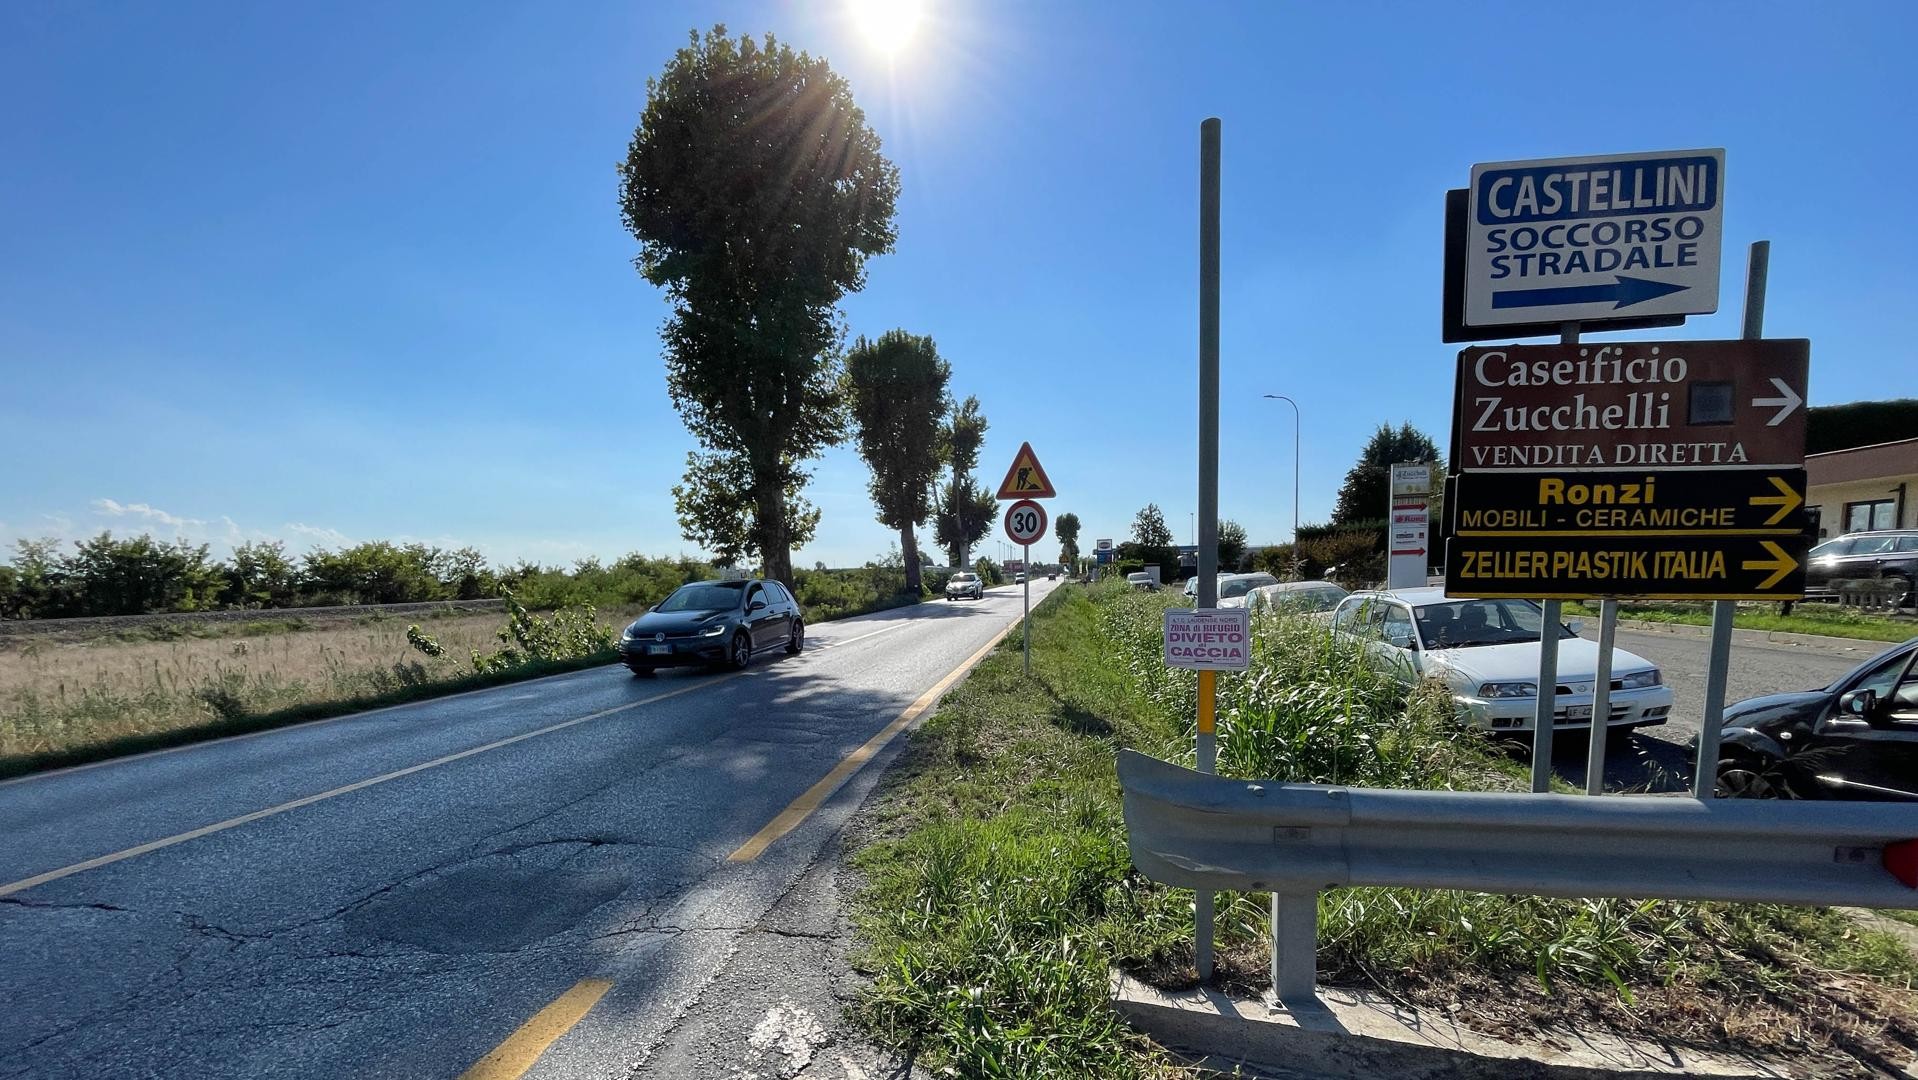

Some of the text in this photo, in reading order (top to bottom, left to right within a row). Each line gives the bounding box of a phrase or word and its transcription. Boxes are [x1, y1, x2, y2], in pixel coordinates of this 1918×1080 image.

[1488, 164, 1707, 219] CASTELLINI
[1487, 216, 1704, 253] SOCCORSO
[1490, 243, 1697, 279] STRADALE
[1474, 347, 1687, 387] Caseificio
[1472, 393, 1670, 432] Zucchelli
[1471, 442, 1748, 466] VENDITA DIRETTA
[1539, 477, 1655, 505] Ronzi
[1014, 512, 1037, 533] 30
[1462, 510, 1547, 527] MOBILI
[1576, 508, 1735, 527] CERAMICHE
[1460, 551, 1726, 579] ZELLER PLASTIK ITALIA
[1169, 633, 1243, 643] DIVIETO
[1170, 624, 1191, 632] ZONA
[1194, 624, 1200, 632] di
[1170, 647, 1242, 657] CACCIA
